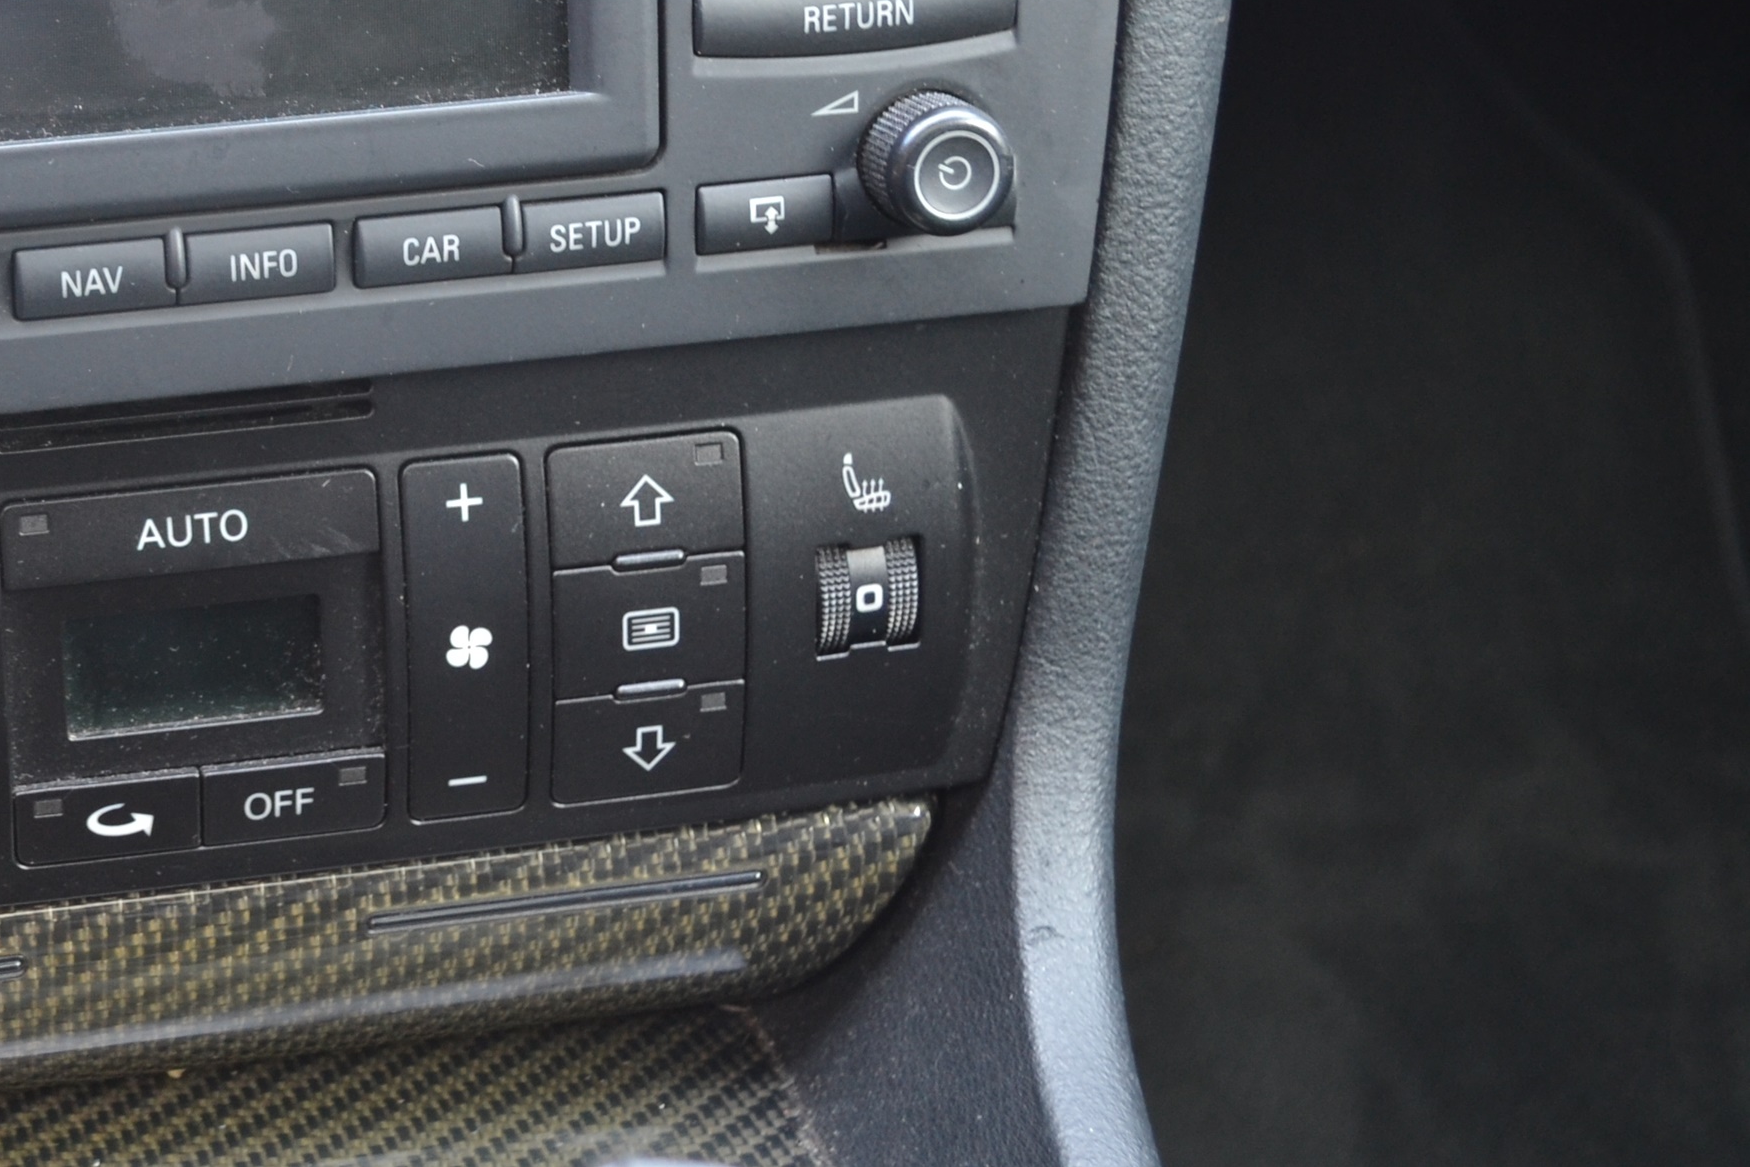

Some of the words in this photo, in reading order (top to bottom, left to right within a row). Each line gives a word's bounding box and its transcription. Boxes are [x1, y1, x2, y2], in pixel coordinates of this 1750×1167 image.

[402, 233, 461, 266] CAR
[549, 216, 642, 254] SETUP
[60, 265, 124, 299] NAV
[229, 248, 299, 282] INFO
[136, 508, 249, 551] AUTO
[243, 786, 315, 821] OFF
